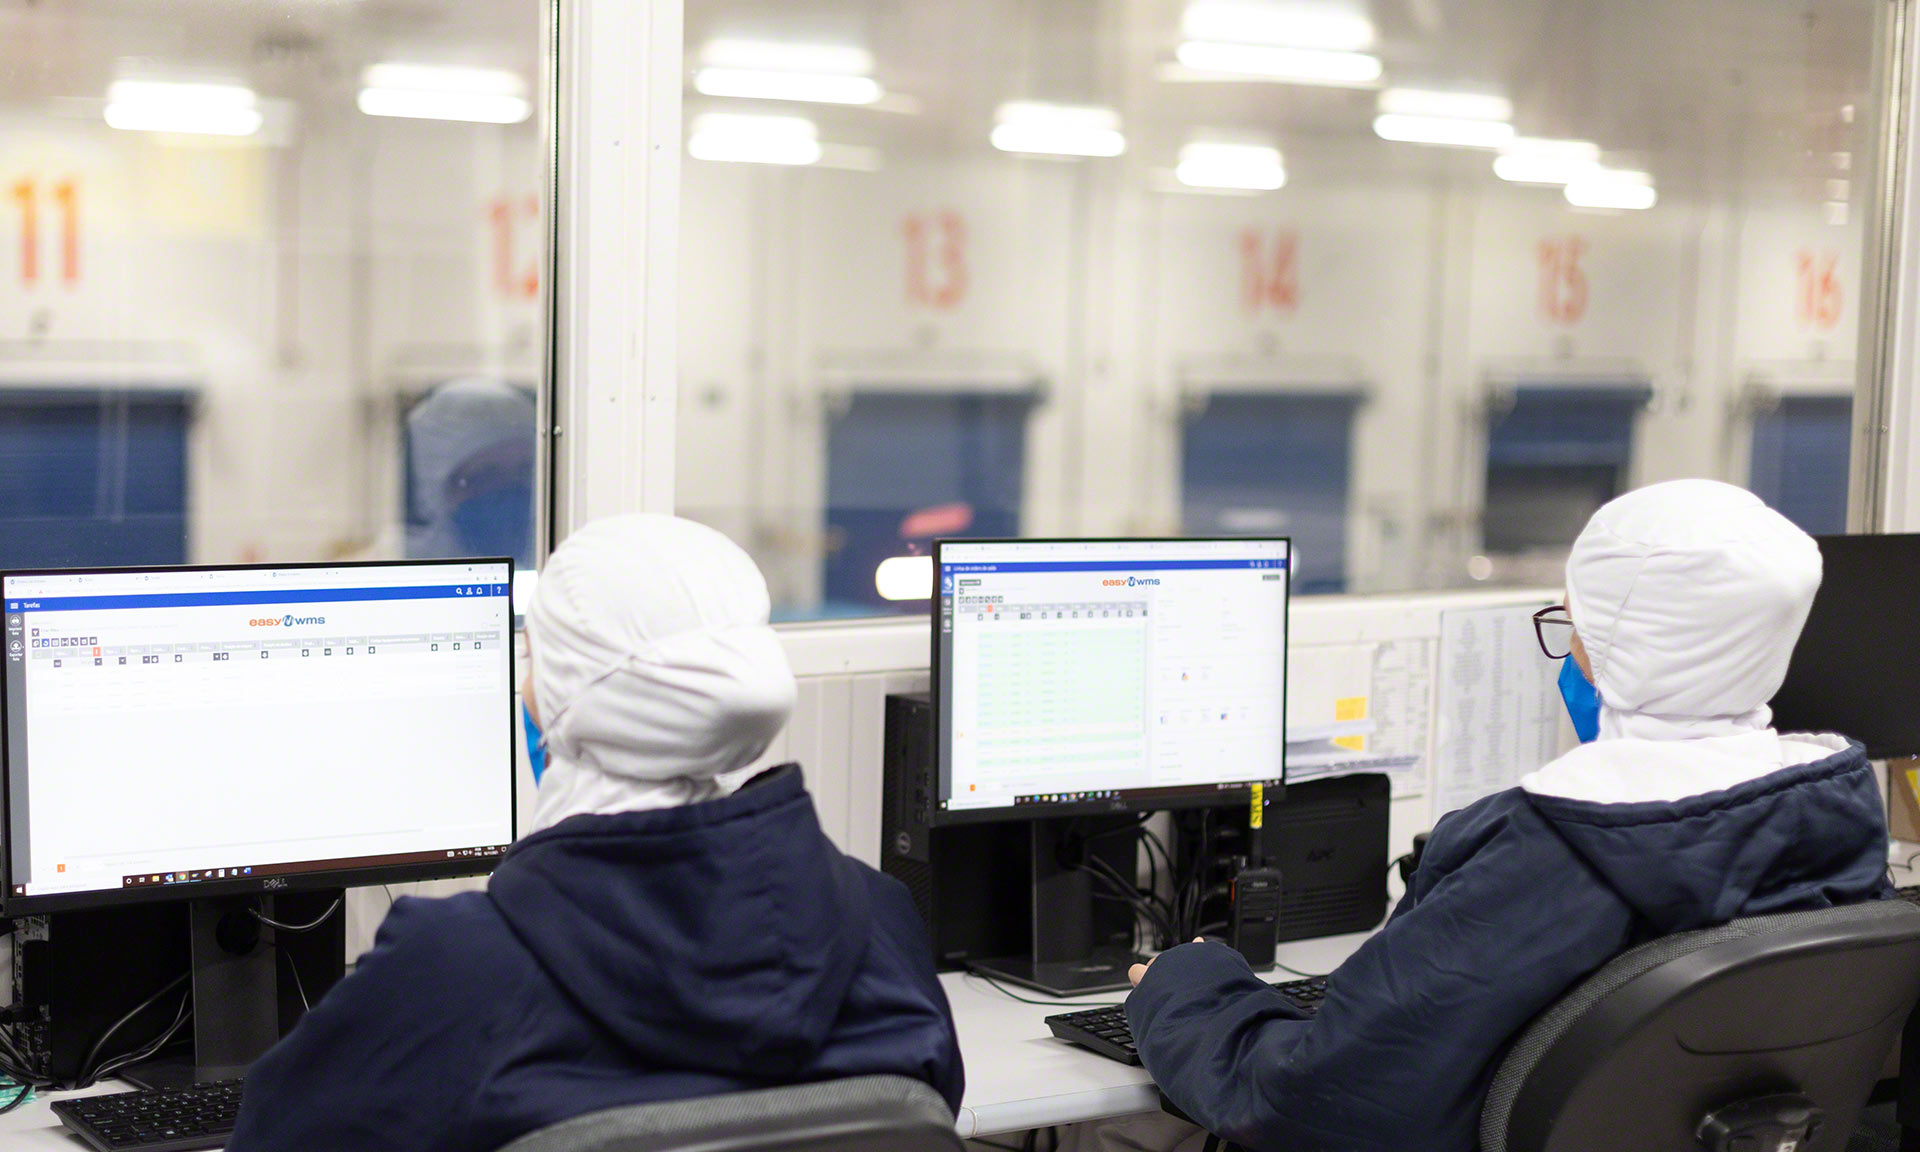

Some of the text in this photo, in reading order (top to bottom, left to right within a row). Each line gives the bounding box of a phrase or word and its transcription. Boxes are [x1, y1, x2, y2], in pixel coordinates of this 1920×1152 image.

[11, 179, 80, 284] 11
[903, 211, 967, 311] 13
[1240, 230, 1298, 314] 14
[1537, 235, 1589, 327] 15
[1797, 248, 1842, 331] 16
[249, 616, 326, 627] easy wms
[1102, 579, 1127, 587] easy
[264, 878, 288, 889] DELL
